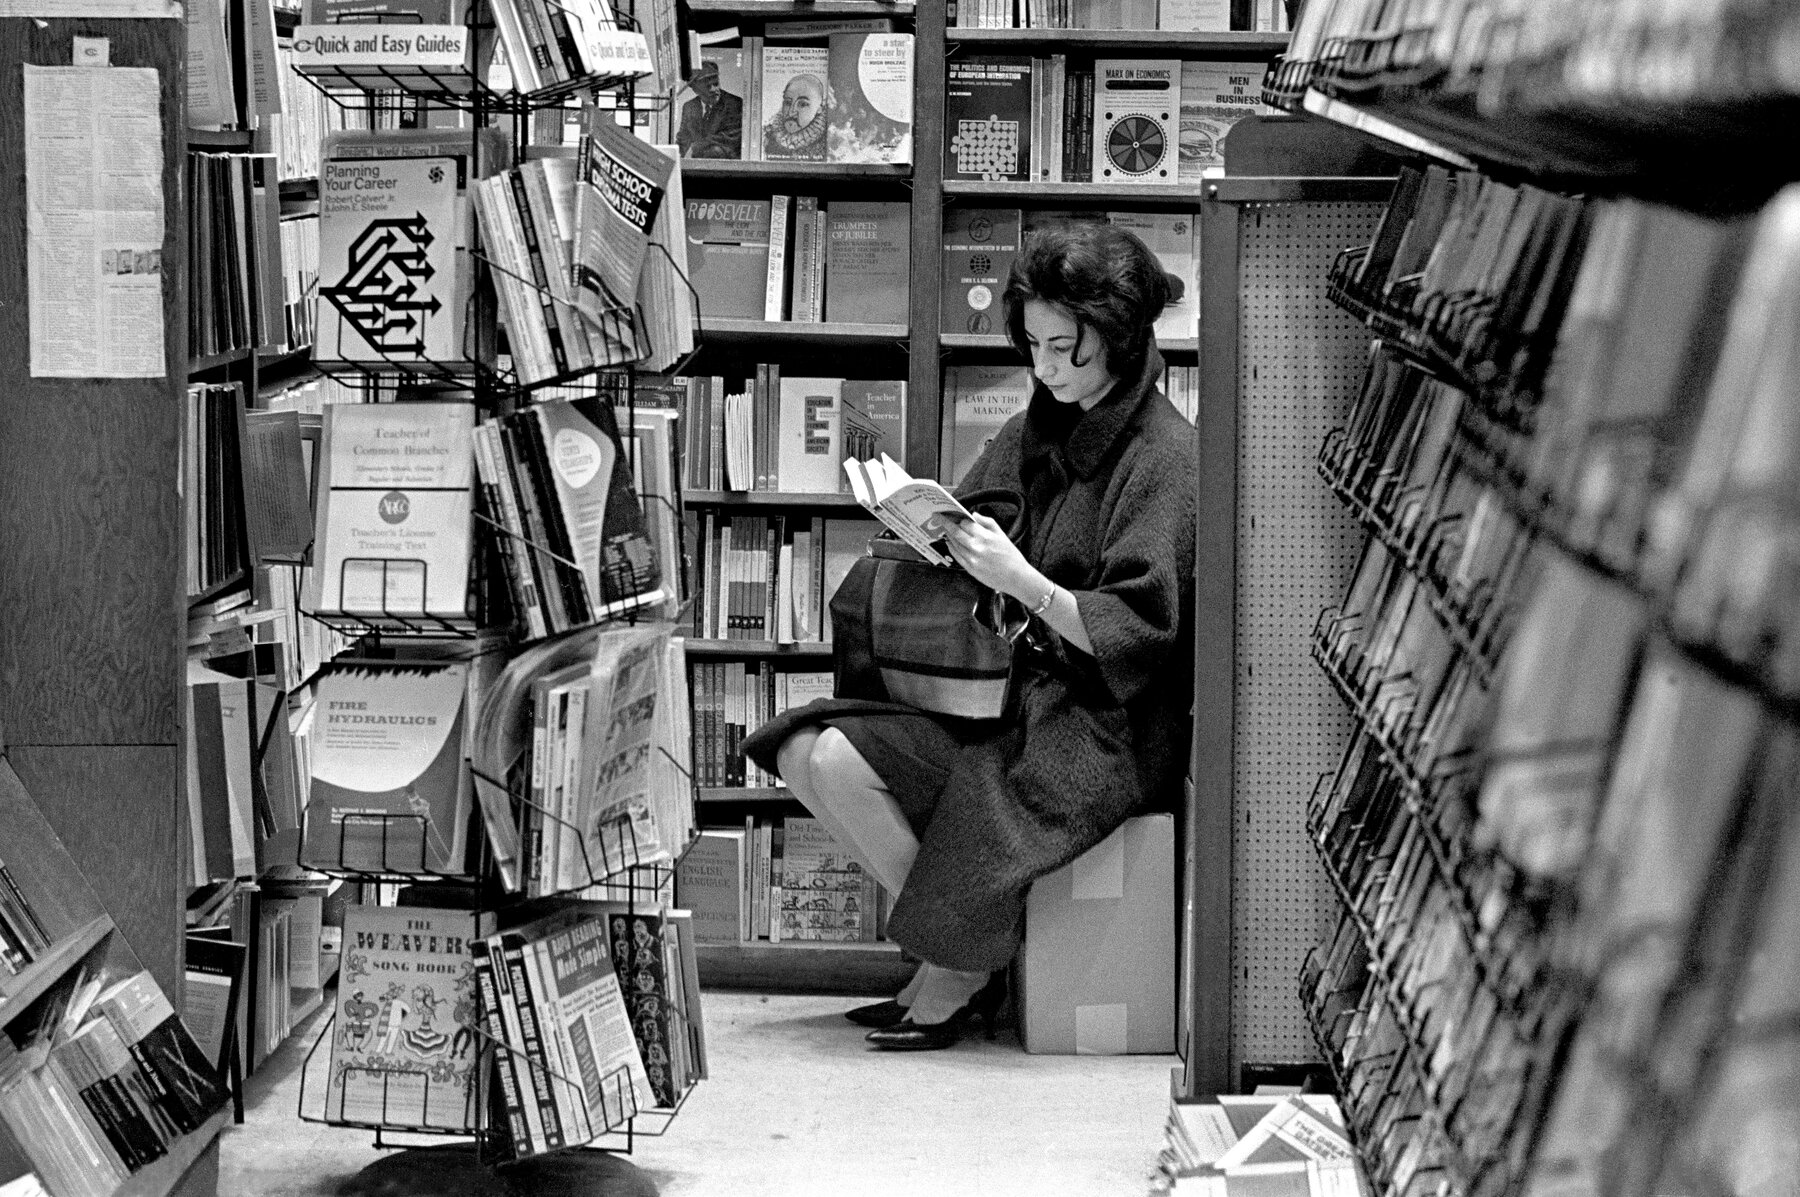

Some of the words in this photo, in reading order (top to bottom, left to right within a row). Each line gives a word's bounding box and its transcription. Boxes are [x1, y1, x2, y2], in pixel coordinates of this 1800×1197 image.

[314, 36, 349, 56] Quick
[354, 35, 377, 52] and
[382, 35, 411, 56] Easy
[416, 34, 461, 52] Guides
[896, 48, 906, 59] by
[999, 65, 1030, 73] ECONOMICS
[1106, 70, 1123, 78] MARX
[1126, 70, 1134, 79] ON
[1136, 70, 1170, 79] ECONOMICS
[986, 72, 1021, 80] INTEGRATION
[1229, 76, 1250, 86] MEN
[1234, 86, 1243, 94] IN
[1216, 95, 1260, 105] BUSINESS
[326, 165, 380, 179] Planning
[325, 179, 352, 191] Your
[354, 178, 398, 190] Career
[612, 164, 652, 203] SCHOOL
[355, 194, 385, 203] Calvert
[361, 203, 388, 212] Steele
[620, 198, 648, 228] TESTS
[772, 196, 786, 248] ROOSEVELT
[832, 221, 877, 230] TRUMPETS
[832, 231, 843, 239] OF
[845, 231, 877, 240] JUBILEE
[866, 393, 896, 402] Teacher
[965, 395, 984, 404] LAW
[987, 395, 999, 404] IN
[1002, 395, 1019, 404] THE
[869, 412, 900, 420] America
[972, 406, 1012, 415] MAKING
[374, 428, 417, 438] Teacher
[420, 427, 430, 438] of
[353, 445, 399, 455] Common
[404, 445, 449, 455] Branches
[792, 676, 813, 684] Great
[818, 676, 832, 684] Teac
[329, 701, 368, 710] FIRE
[328, 714, 437, 725] HYDRAULICS
[696, 703, 704, 736] CREATIVE
[706, 703, 714, 736] CREATIVE
[715, 703, 724, 736] CREATIVE
[696, 738, 704, 764] POWER
[706, 738, 714, 764] POWER
[716, 738, 724, 764] POWER
[682, 865, 723, 877] ENGLISH
[682, 876, 730, 888] LANGUAGE
[408, 920, 431, 930] THE
[356, 932, 472, 954] WEAVERS
[556, 951, 578, 980] Made
[578, 938, 607, 968] Simple
[373, 961, 410, 973] SONG
[417, 963, 456, 974] BOOK
[480, 972, 496, 1011] PICTORIAL
[510, 965, 528, 1006] PICTORIAL
[489, 1012, 504, 1044] HISTORY
[519, 1006, 536, 1040] HISTORY
[526, 1040, 539, 1054] OF
[496, 1048, 508, 1060] OF
[132, 1044, 145, 1061] Usage
[149, 1072, 168, 1096] Abusage
[499, 1060, 518, 1107] PHILOSOPHY
[530, 1054, 550, 1100] PHILOSOPHY
[1295, 1119, 1316, 1136] THE
[1294, 1130, 1336, 1161] GATSBY
